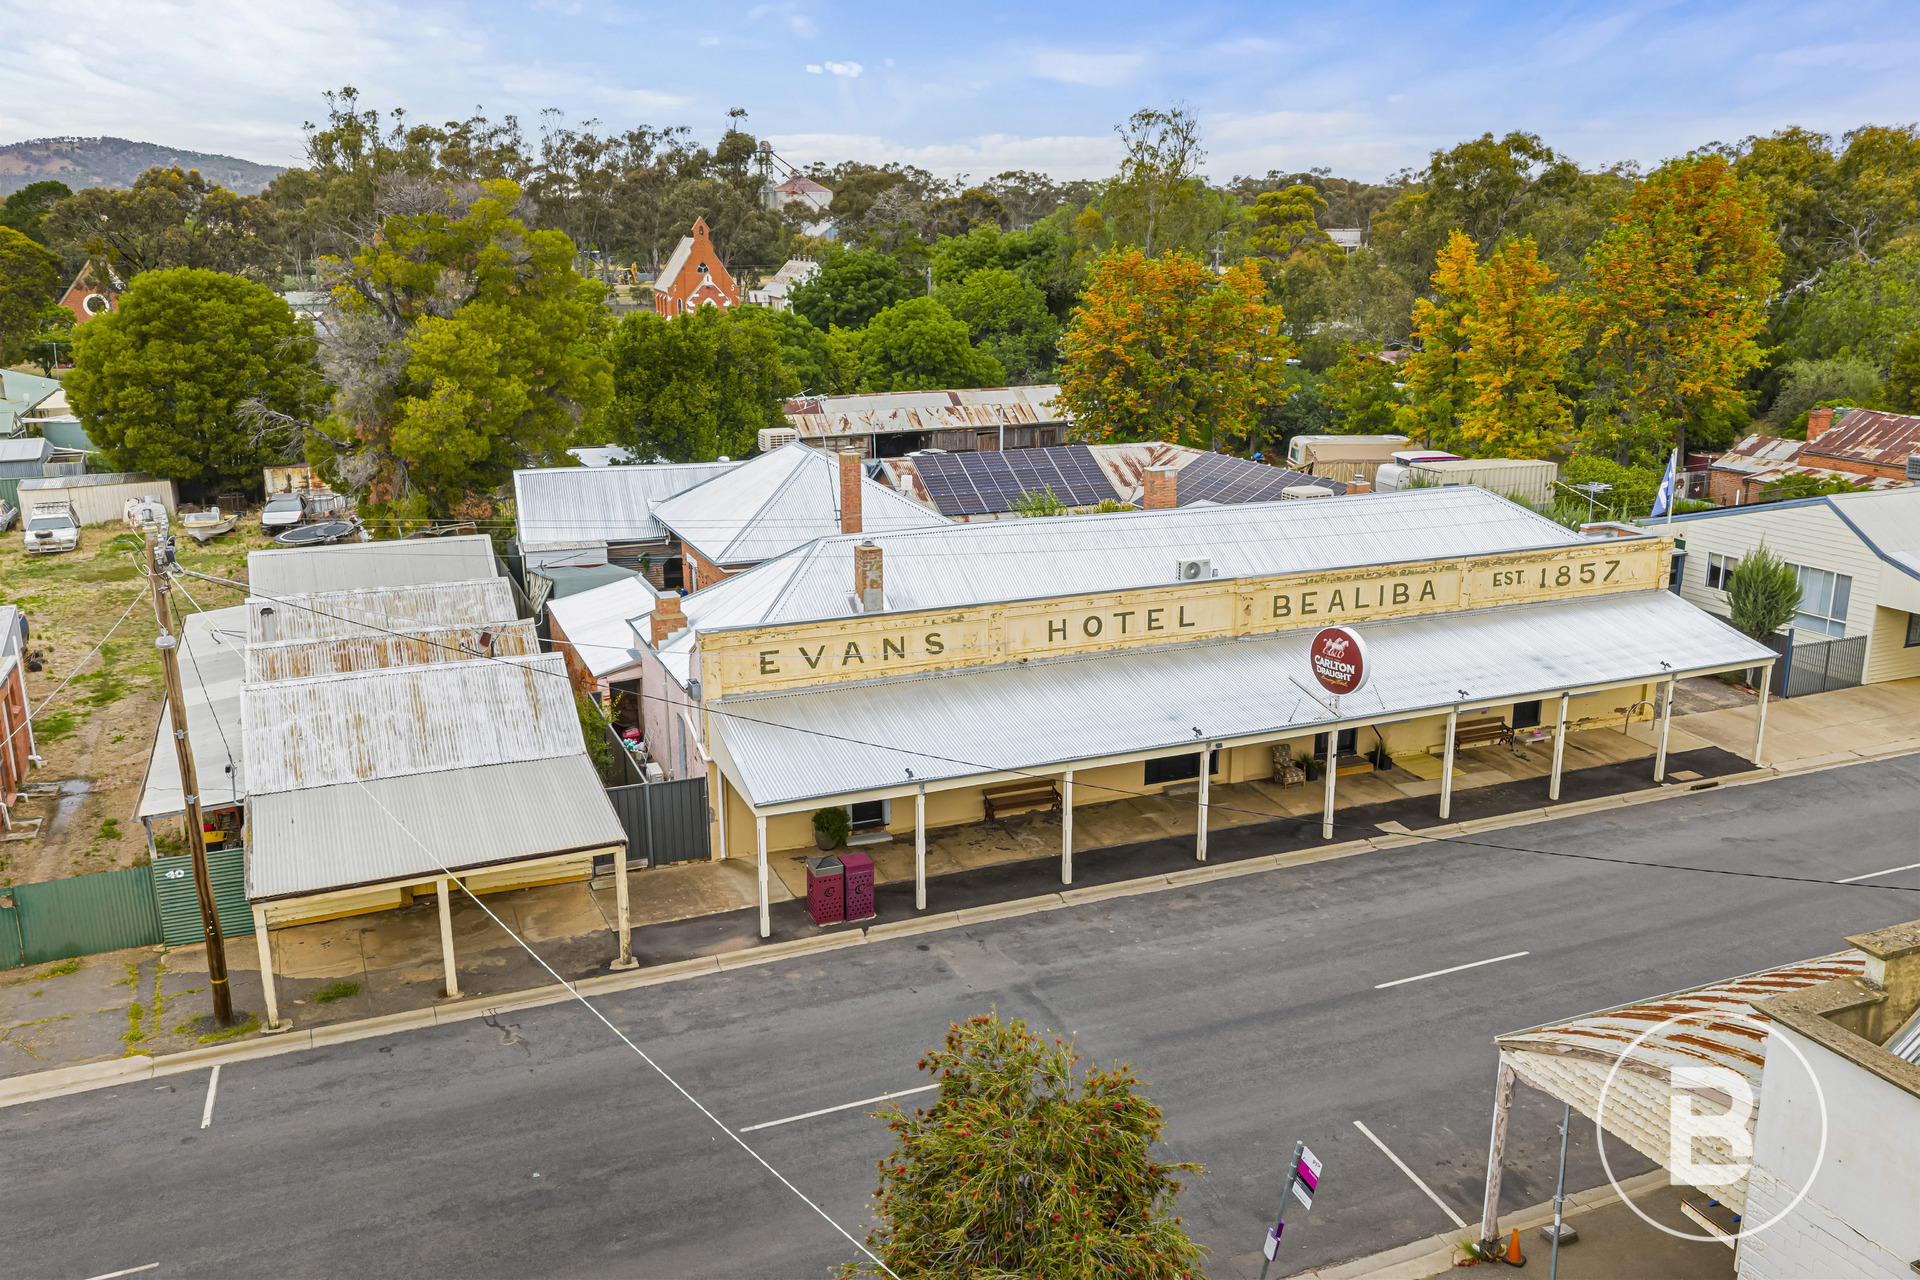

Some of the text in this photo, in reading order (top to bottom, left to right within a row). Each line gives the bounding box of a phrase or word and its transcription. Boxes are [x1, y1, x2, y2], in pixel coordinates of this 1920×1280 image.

[759, 560, 1620, 675] EVANS HOTEL BEALIBA EST. 1857
[1314, 654, 1356, 675] CARLTON
[1316, 664, 1352, 682] DRAUGHT
[165, 868, 185, 879] 40
